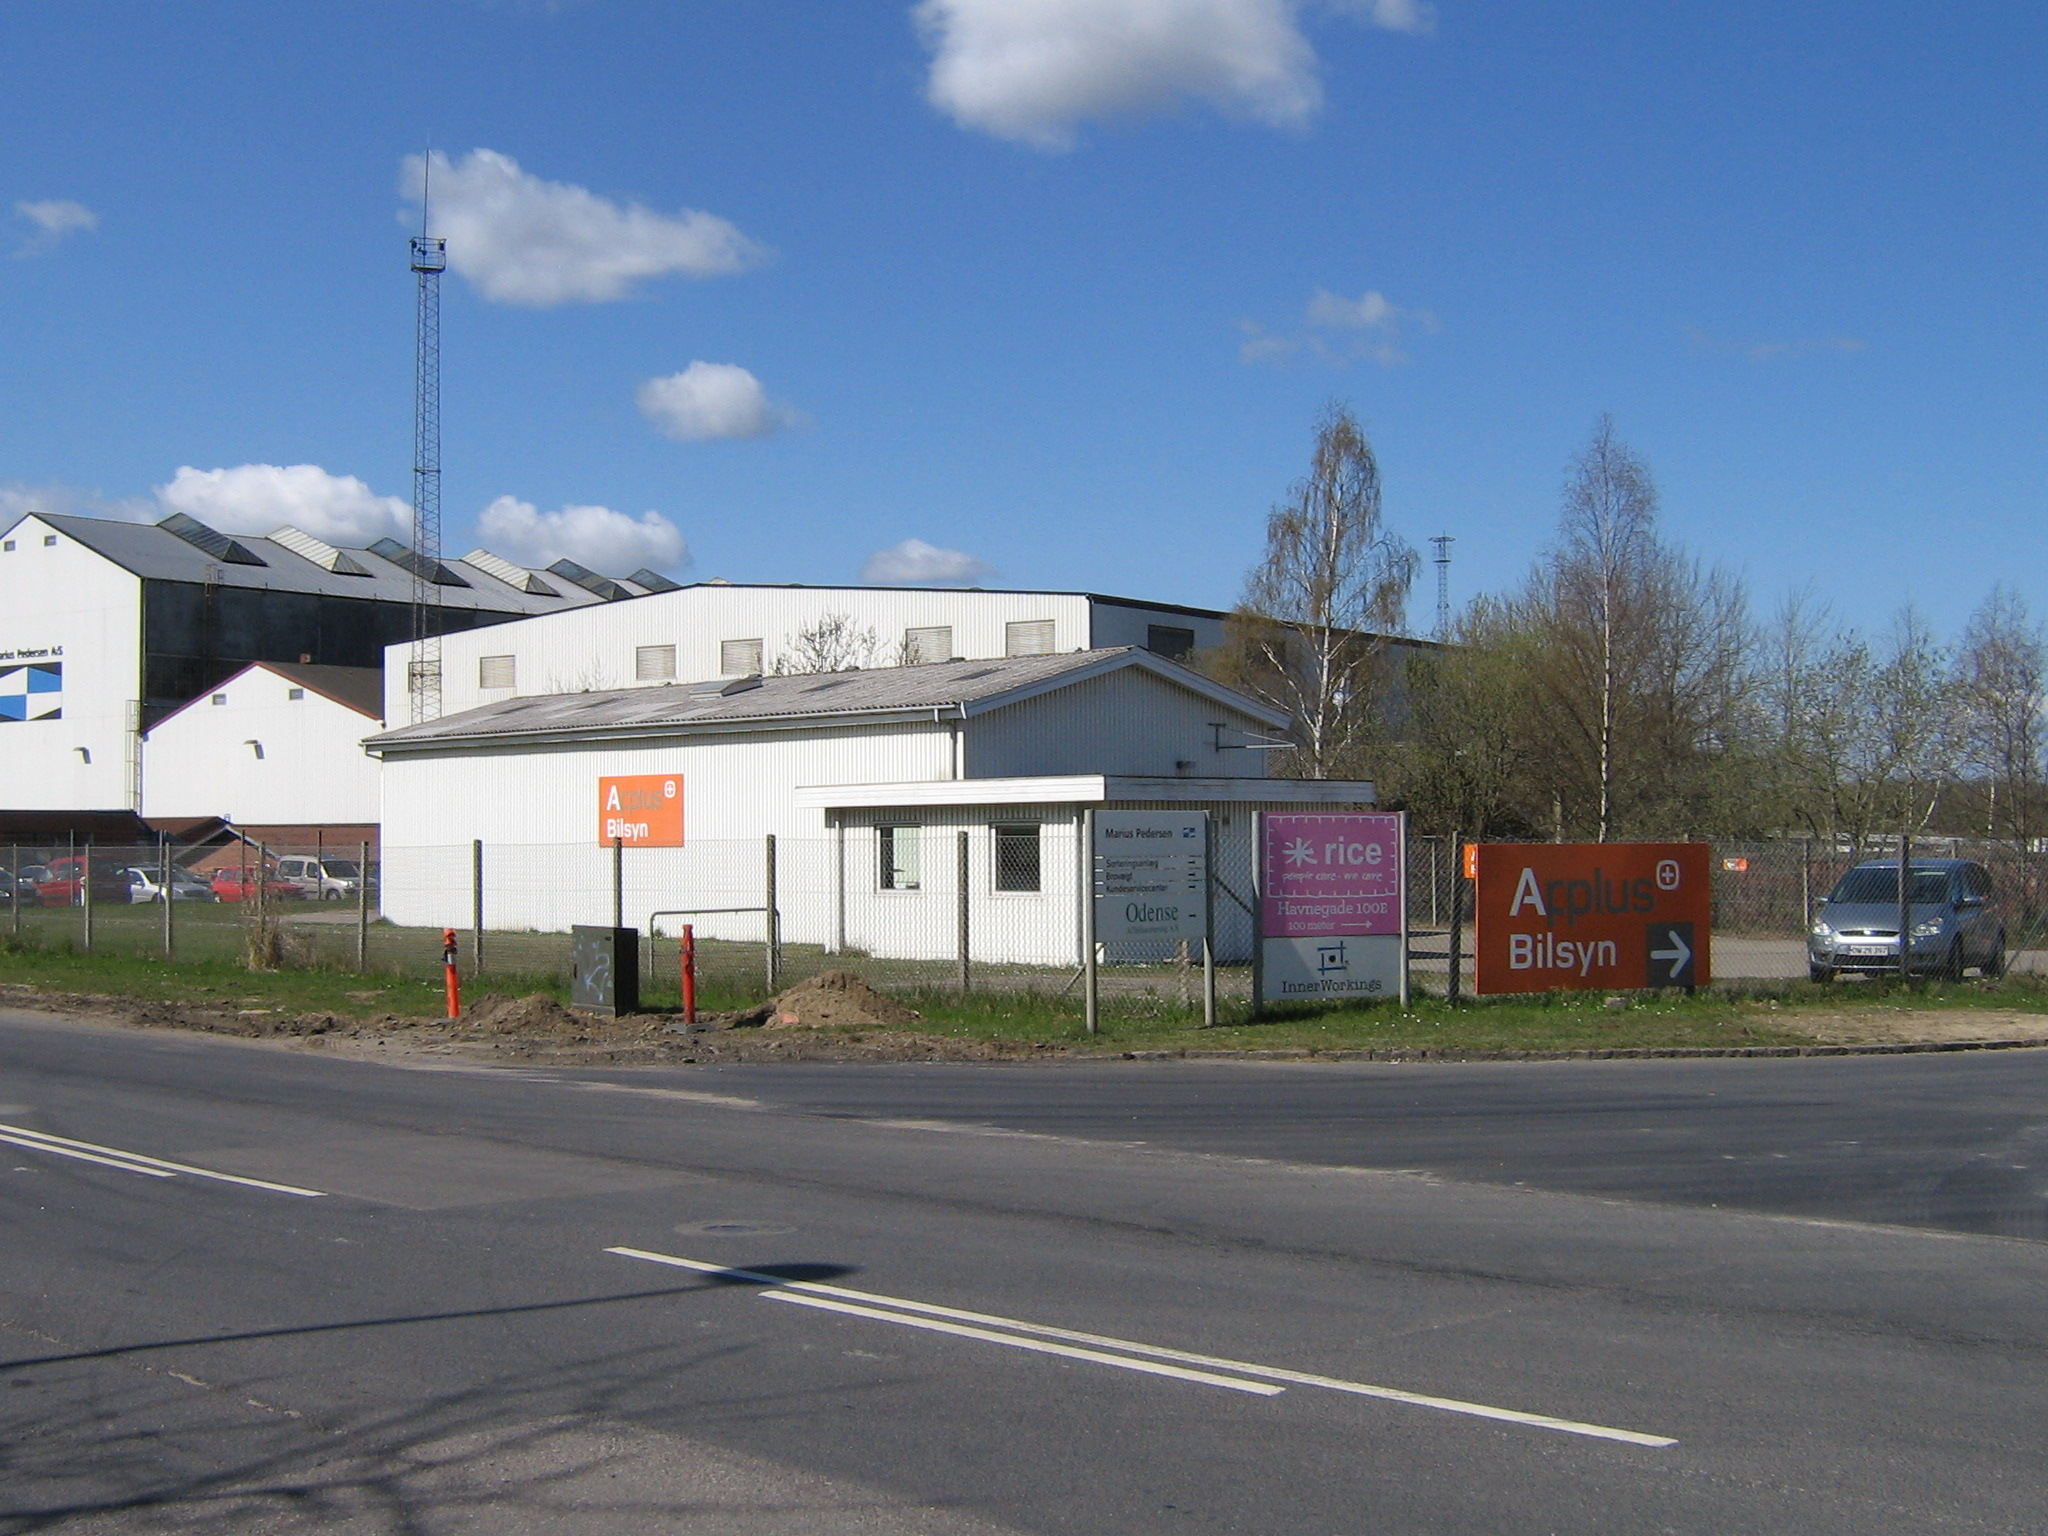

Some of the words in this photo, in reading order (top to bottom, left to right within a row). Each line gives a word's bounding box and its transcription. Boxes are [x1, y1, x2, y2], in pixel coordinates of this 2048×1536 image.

[606, 818, 648, 841] Bilsyn
[1105, 828, 1134, 839] Marius
[1136, 828, 1173, 839] Pedersen
[1325, 836, 1383, 865] rice
[1316, 871, 1337, 881] care
[1362, 871, 1383, 882] care
[1126, 902, 1179, 922] Odense
[1277, 900, 1354, 918] Havnegade
[1288, 921, 1306, 931] 100
[1308, 921, 1336, 931] meter
[1509, 932, 1617, 977] Bilsyn
[1282, 978, 1383, 994] InnerWorkings
